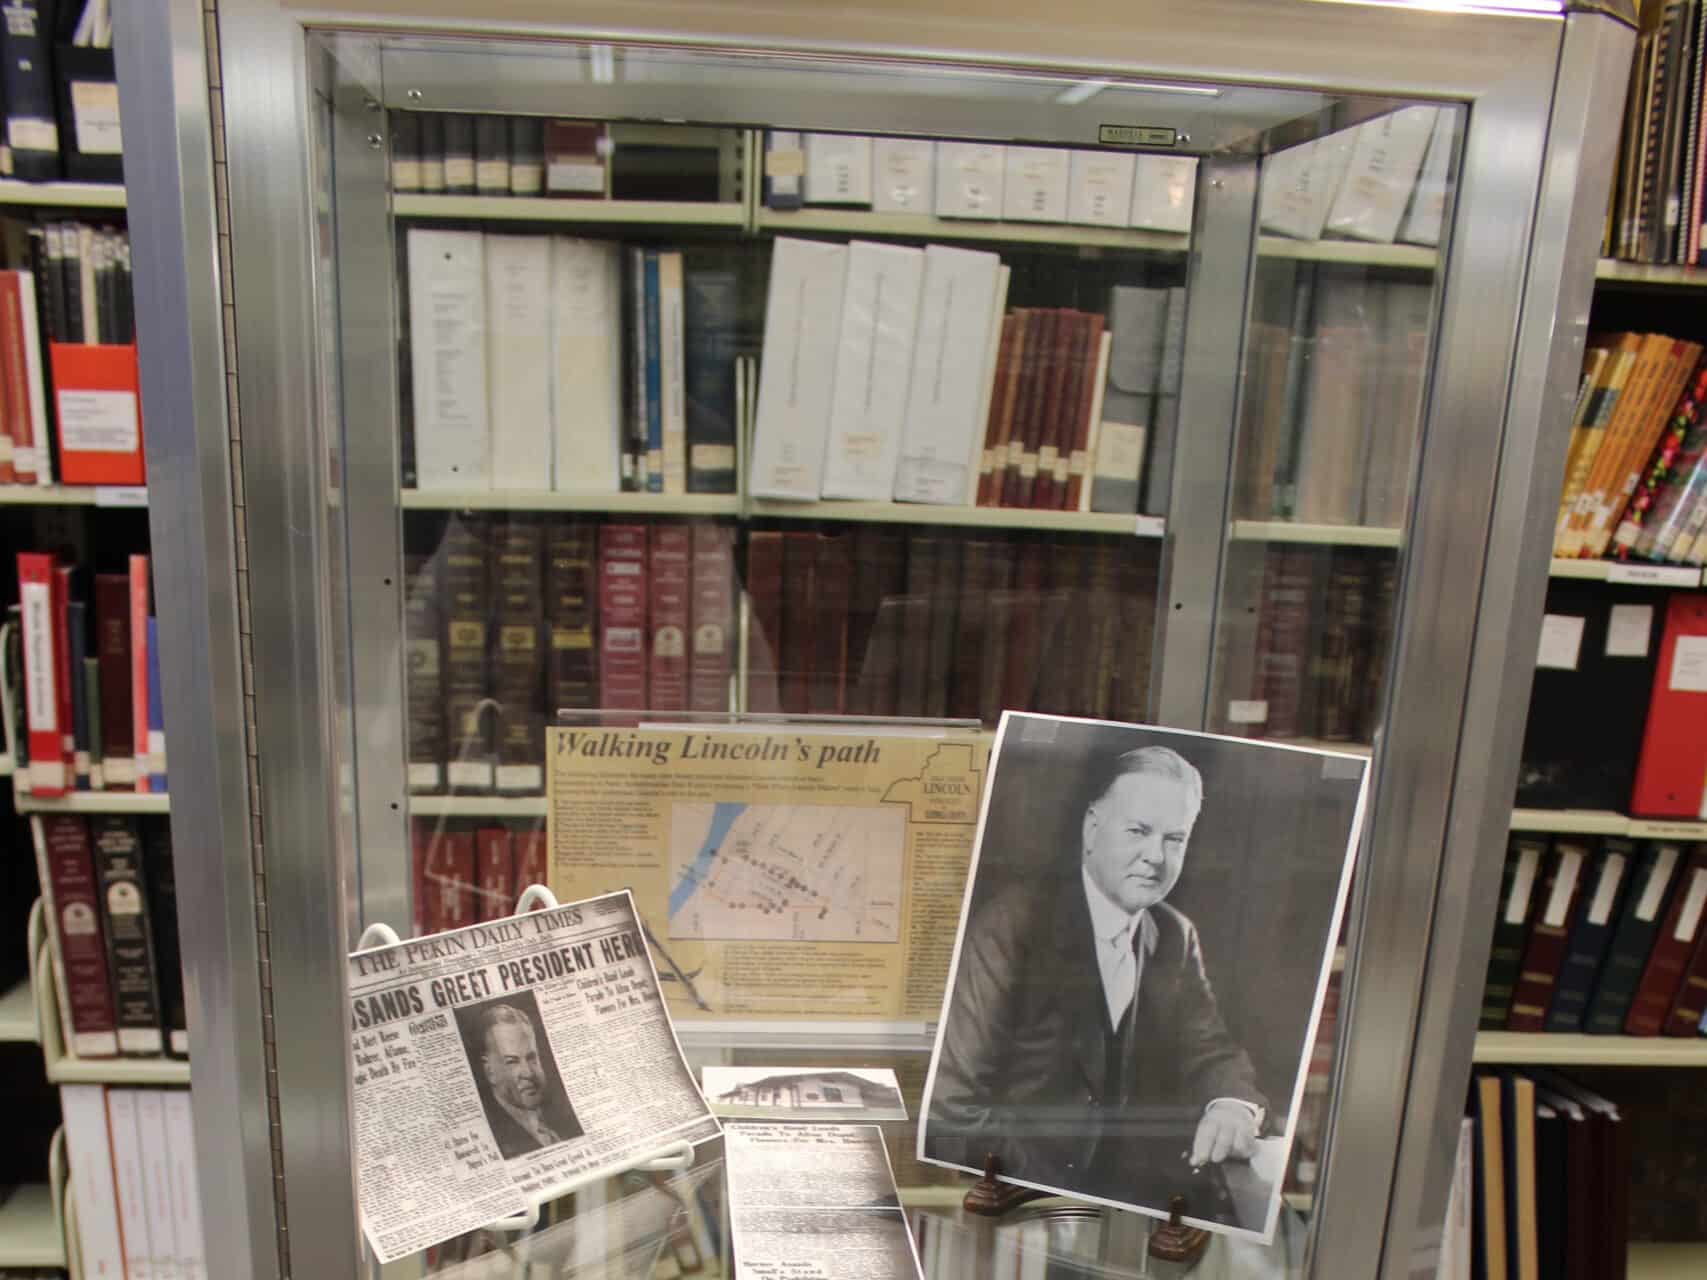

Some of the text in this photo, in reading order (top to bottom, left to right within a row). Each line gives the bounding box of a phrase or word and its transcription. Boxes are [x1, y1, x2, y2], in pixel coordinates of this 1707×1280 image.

[556, 732, 881, 768] Walking Lincoln's path
[357, 908, 583, 977] THE PEKIN DAILY TIMES
[431, 969, 492, 1007] GREET
[498, 942, 595, 991] PRESIDENT
